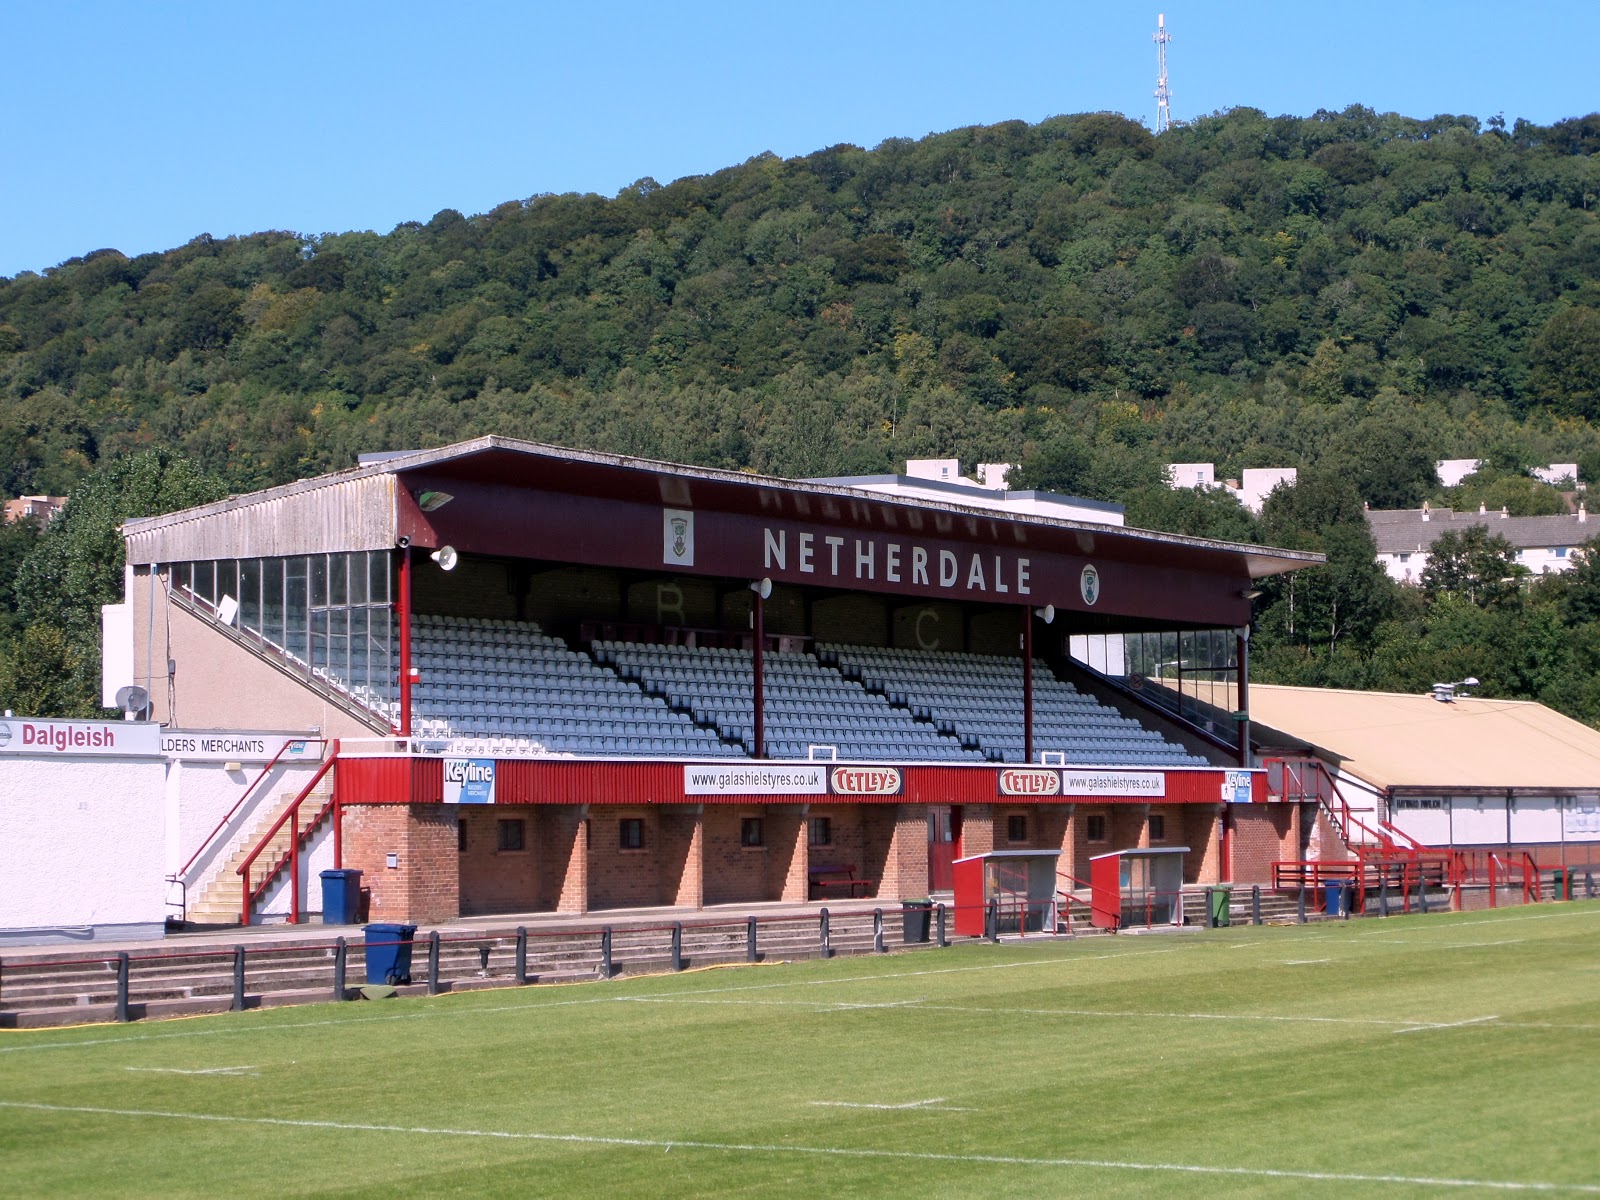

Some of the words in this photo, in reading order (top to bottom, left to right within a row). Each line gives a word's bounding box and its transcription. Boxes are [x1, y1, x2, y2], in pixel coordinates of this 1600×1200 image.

[764, 528, 1031, 594] NETHERDALE
[916, 610, 939, 651] C
[22, 724, 115, 751] Dalgleish
[161, 738, 196, 752] LDERS
[201, 739, 264, 753] MERCHANTS
[445, 762, 493, 788] Keyline
[691, 770, 819, 791] www.galashielstyres.co.uk
[834, 769, 897, 791] TETLEY'S
[1003, 771, 1057, 793] TETLEY'S
[1069, 775, 1160, 792] www.galashielstyres.co.uk
[1226, 773, 1250, 792] Keyline
